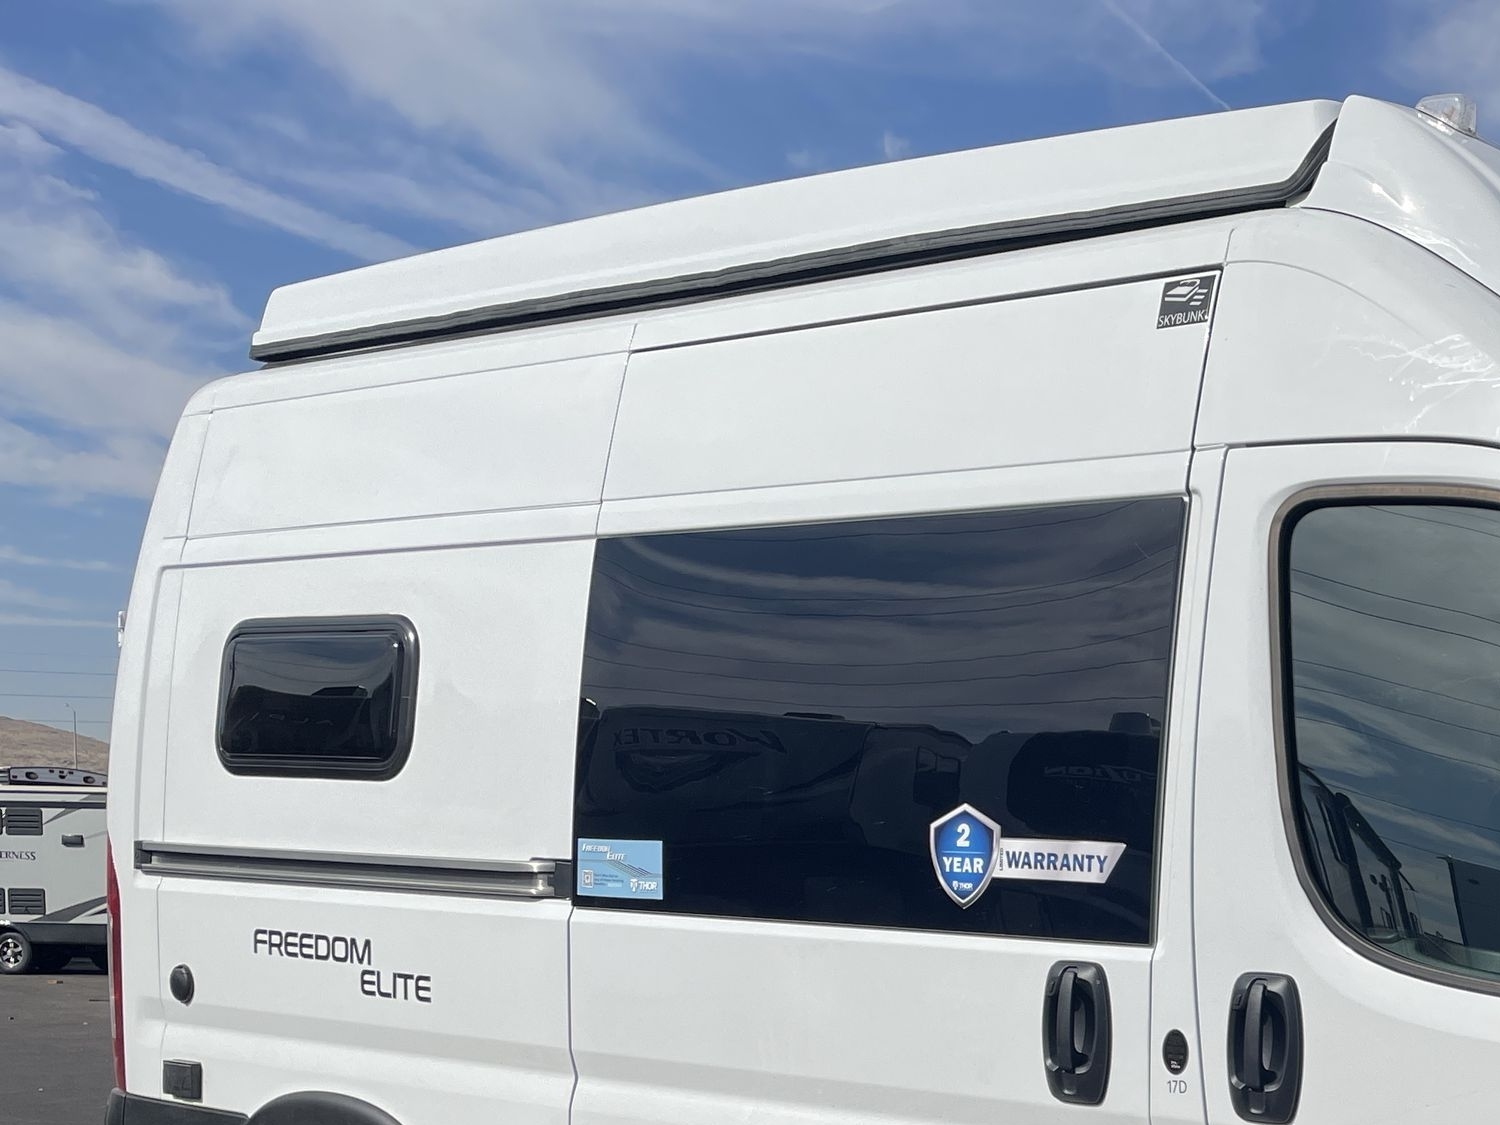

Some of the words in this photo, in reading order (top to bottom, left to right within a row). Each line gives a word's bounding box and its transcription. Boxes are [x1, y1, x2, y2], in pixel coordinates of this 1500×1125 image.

[1158, 309, 1206, 328] SKYBUNK
[956, 823, 971, 847] 2
[942, 856, 985, 874] YEAR
[1006, 850, 1108, 873] WARRANTY
[639, 882, 657, 890] THOR
[253, 928, 372, 966] FREEDOM
[360, 969, 432, 1003] ELITE
[1167, 1079, 1188, 1094] 17D
